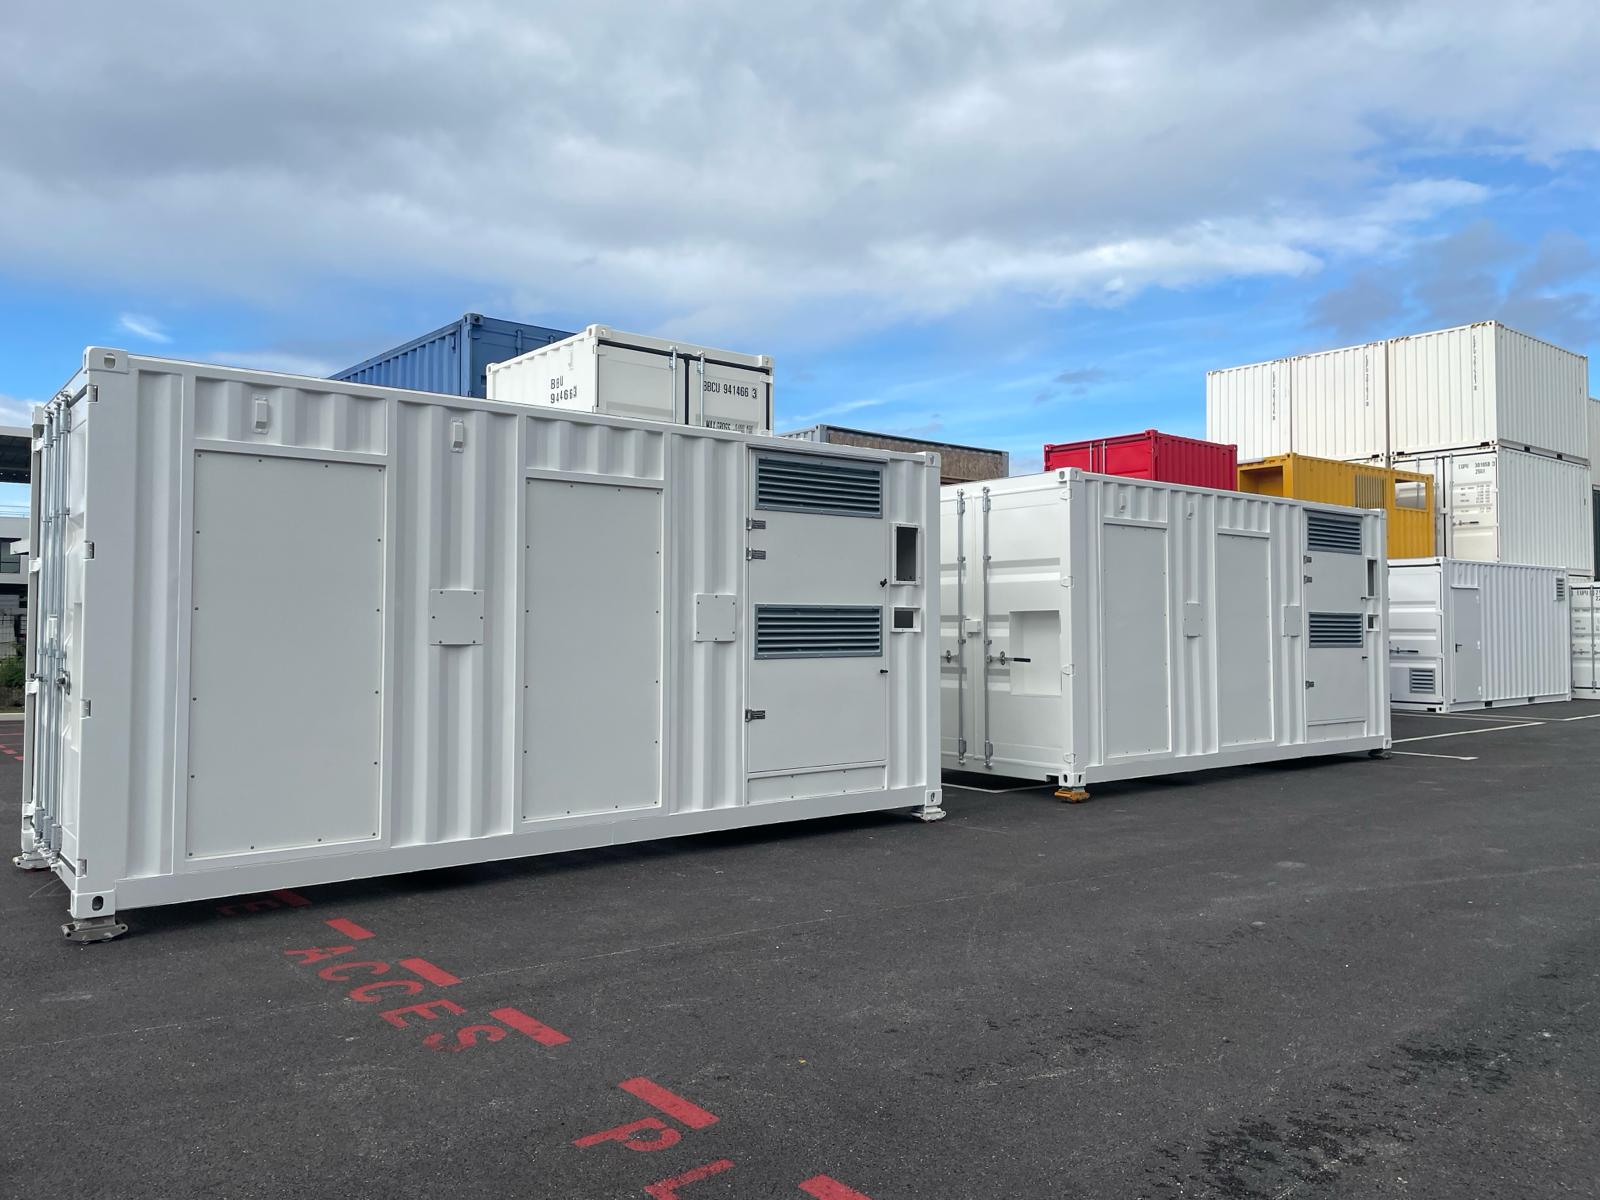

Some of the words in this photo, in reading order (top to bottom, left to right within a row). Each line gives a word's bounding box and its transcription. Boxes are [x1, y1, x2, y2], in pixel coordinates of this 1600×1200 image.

[723, 384, 749, 398] 941466
[752, 388, 758, 399] 3
[284, 944, 507, 1052] ACCES
